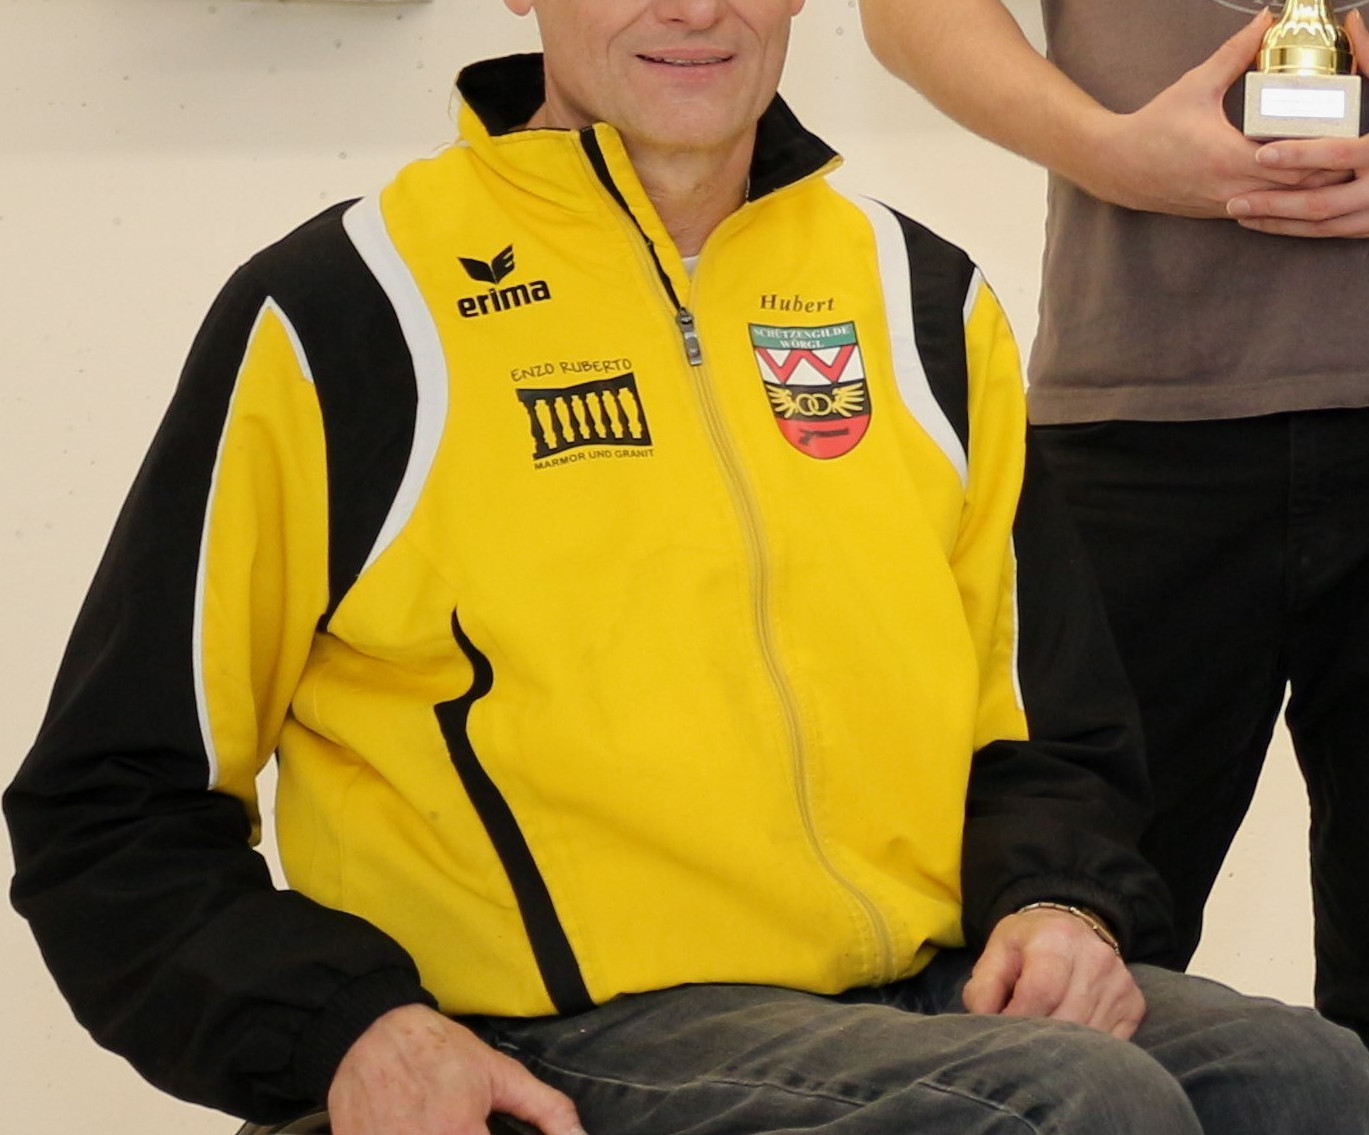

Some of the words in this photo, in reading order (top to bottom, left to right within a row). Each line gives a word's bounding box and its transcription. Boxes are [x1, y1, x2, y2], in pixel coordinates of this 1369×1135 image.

[457, 280, 551, 318] erima
[759, 294, 835, 313] Hubert
[753, 325, 851, 340] SCHÜTZENGILDE
[779, 338, 825, 350] WÖRGL
[510, 362, 555, 383] ENZO
[559, 358, 633, 375] RUBERTO
[534, 451, 587, 470] MARMOR
[588, 450, 612, 459] UND
[614, 448, 654, 458] GRANIT
